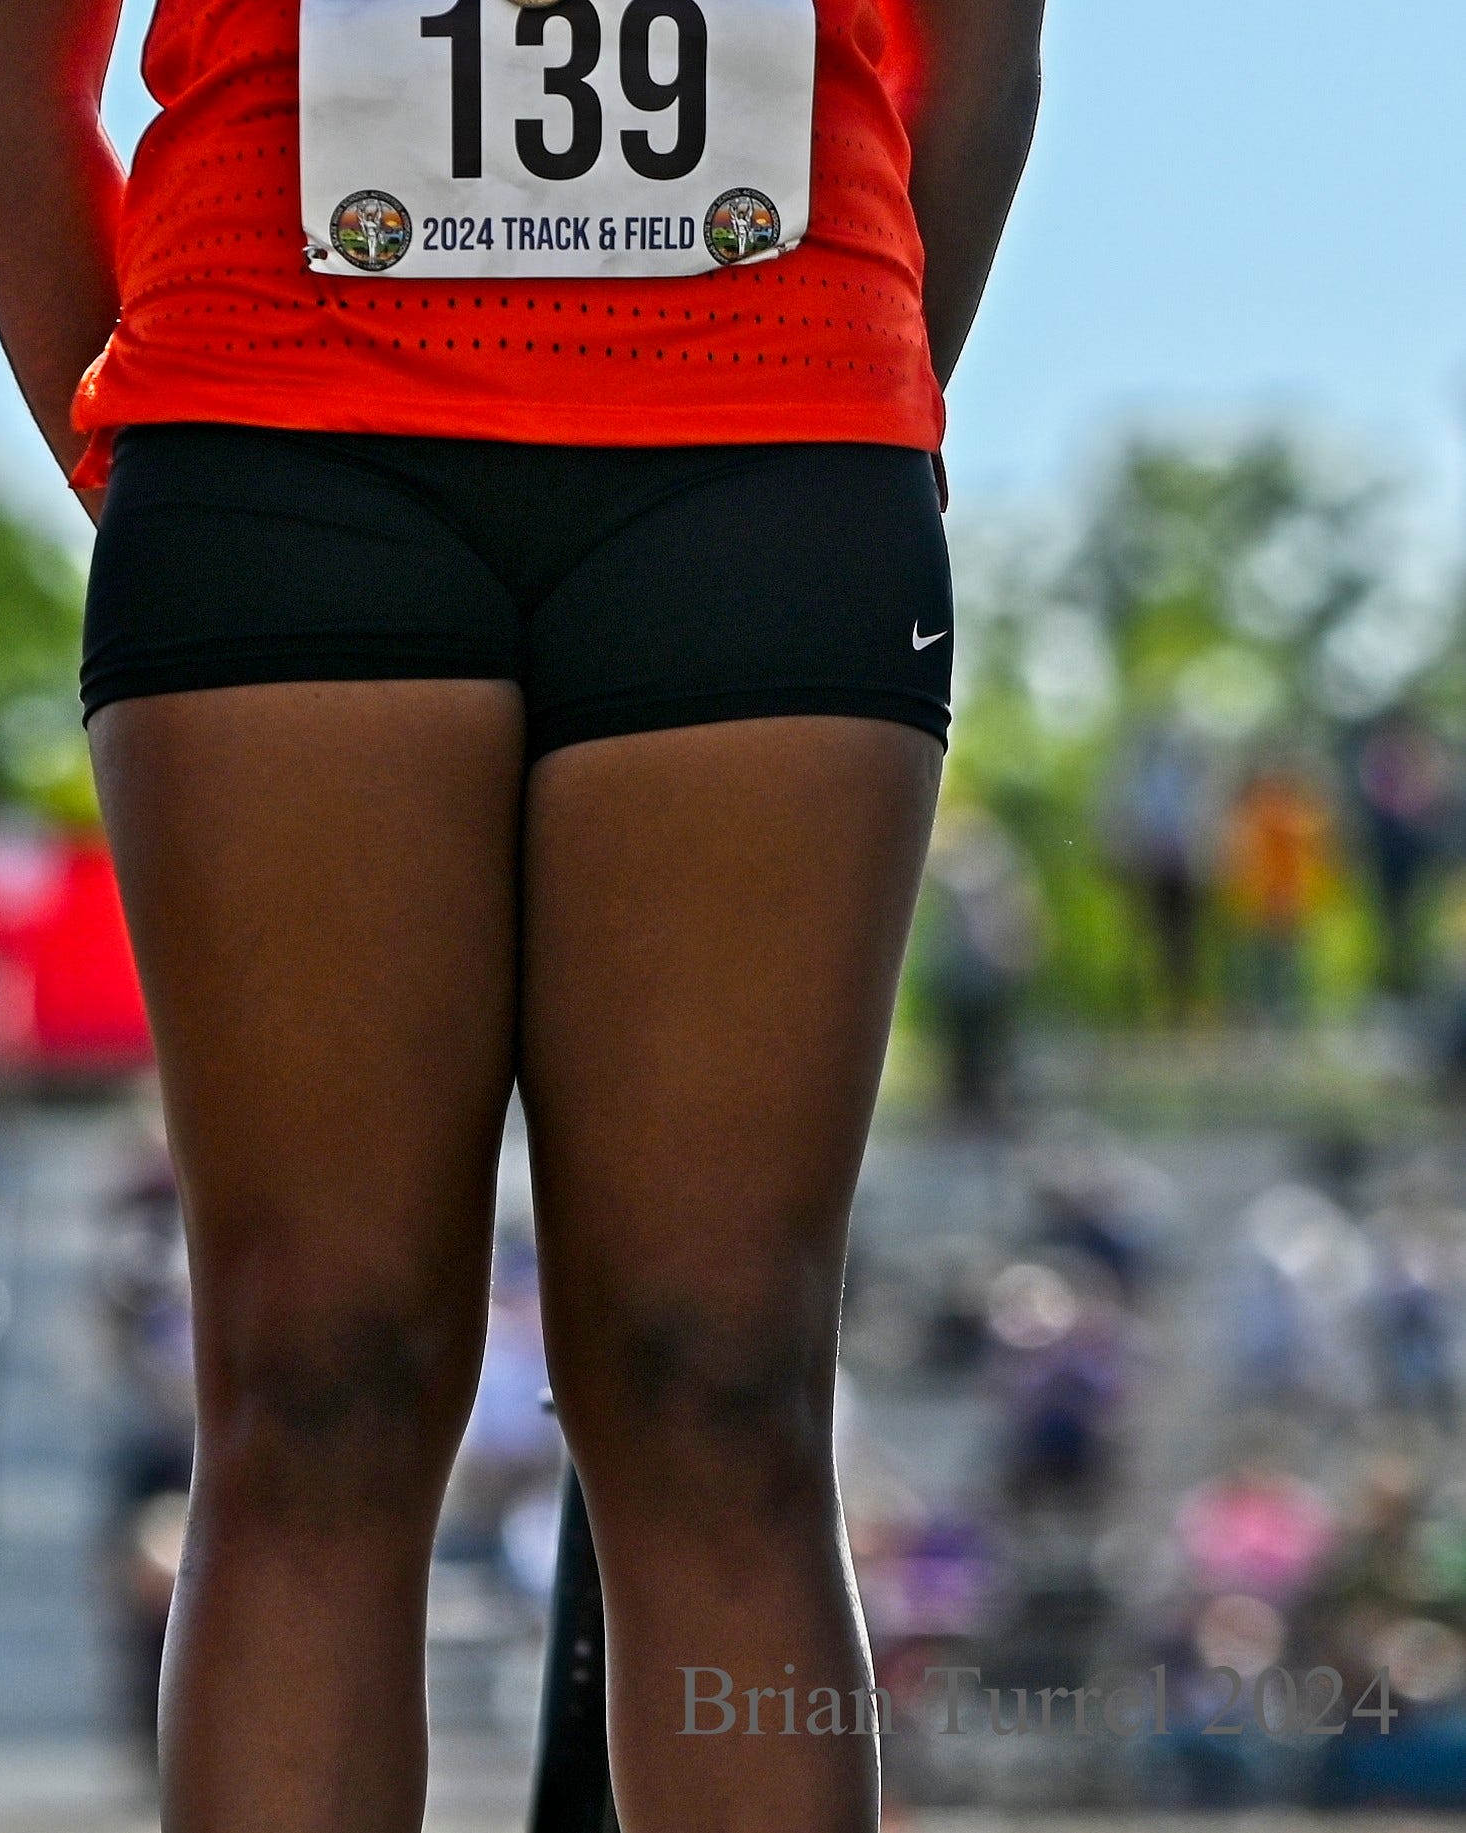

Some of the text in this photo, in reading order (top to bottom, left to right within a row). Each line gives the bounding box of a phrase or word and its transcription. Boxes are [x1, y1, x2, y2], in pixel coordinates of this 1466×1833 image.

[423, 218, 494, 251] 2024
[502, 217, 591, 250] TRACK
[599, 217, 617, 250] &
[625, 216, 695, 250] FIELD
